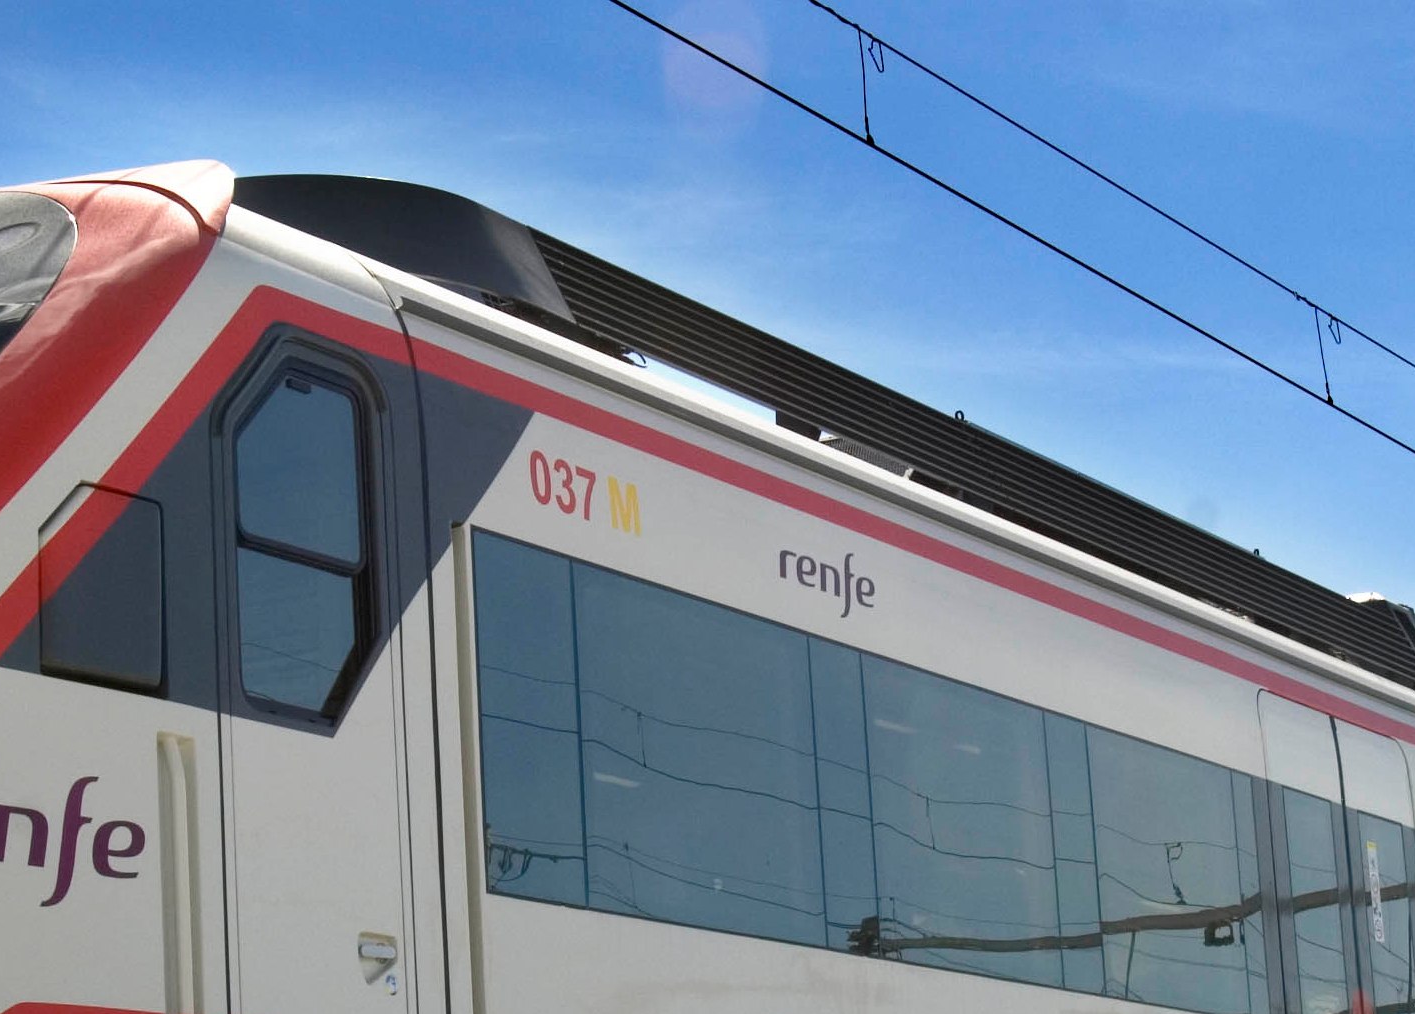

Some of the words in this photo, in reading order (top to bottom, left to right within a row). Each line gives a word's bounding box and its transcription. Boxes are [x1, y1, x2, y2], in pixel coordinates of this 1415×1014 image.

[529, 450, 597, 521] 037
[606, 475, 642, 537] M
[779, 549, 876, 618] renfe
